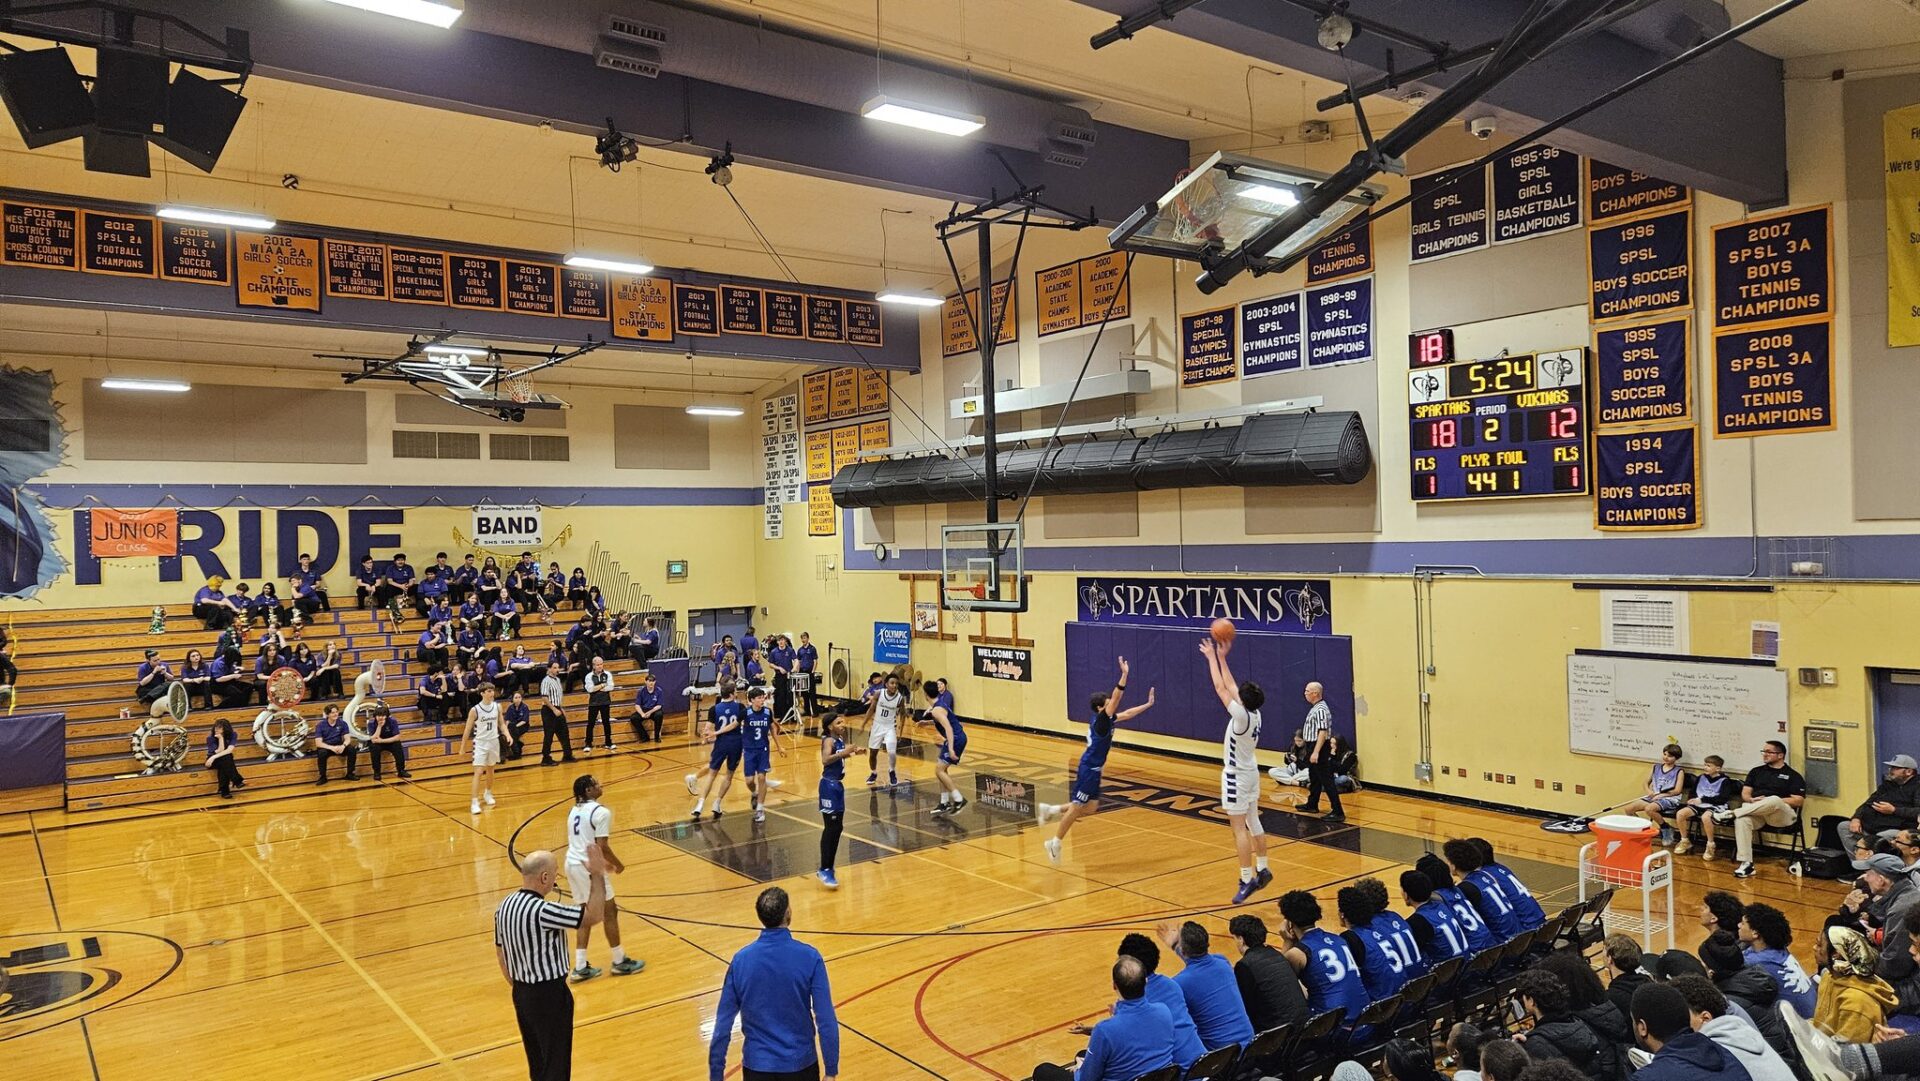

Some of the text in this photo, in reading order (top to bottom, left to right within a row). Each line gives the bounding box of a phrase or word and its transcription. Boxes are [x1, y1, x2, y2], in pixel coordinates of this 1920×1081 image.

[1520, 166, 1550, 182] SPSL
[1890, 161, 1912, 174] We're
[1592, 174, 1625, 192] BOYS
[1518, 182, 1553, 199] GIRLS
[1433, 194, 1462, 209] SPSL
[1600, 186, 1677, 212] CHAMPIONS
[24, 208, 55, 218] 2012
[1497, 195, 1576, 221] BASKETBALL
[6, 216, 72, 230] WEST CENTRAL
[104, 221, 134, 231] 2012
[1412, 209, 1486, 235] GIRLS TENNIS
[1501, 212, 1571, 237] CHAMPIONS
[10, 224, 69, 238] DISTRICT III
[97, 232, 142, 244] SPSL 2A
[180, 228, 208, 238] 2012
[1621, 224, 1655, 242] 1996
[1748, 222, 1791, 242] 2007
[29, 236, 51, 244] BOYS
[173, 237, 215, 248] SPSL 2A
[264, 236, 292, 246] 2012
[1418, 232, 1479, 255] CHAMPIONS
[6, 242, 72, 256] CROSS COUNTRY
[98, 245, 141, 256] FOOTBALL
[183, 248, 207, 257] GIRLS
[250, 244, 305, 257] WIAA 2A
[330, 244, 382, 255] 2012-2013
[1322, 243, 1356, 259] TENNIS
[1728, 238, 1811, 264] SPSL 3A
[15, 252, 64, 264] CHAMPIONS
[96, 257, 143, 268] CHAMPIONS
[180, 257, 211, 267] SOCCER
[244, 252, 312, 267] GIRLS SOCCER
[352, 254, 381, 263] CENTRAL
[392, 254, 442, 265] 2012-2013
[1096, 257, 1111, 268] 2000
[1619, 248, 1657, 265] SPSL
[333, 260, 364, 269] DISTRICT
[392, 265, 442, 276] SPECIAL OLYMPICS
[464, 260, 486, 269] 2013
[1313, 254, 1366, 275] CHAMPIONS
[1746, 260, 1792, 279] BOYS
[173, 266, 217, 278] CHAMPIONS
[459, 269, 477, 277] SPSL
[1090, 268, 1118, 282] ACADEMIC
[1593, 265, 1687, 292] BOYS SOCCER
[261, 275, 298, 286] STATE
[350, 278, 383, 287] BASKETBALL
[397, 276, 439, 286] BASKETBALL
[467, 278, 485, 286] GIRLS
[1045, 281, 1072, 293] ACADEMIC
[1095, 282, 1113, 293] STATE
[248, 283, 312, 296] CHAMPIONS
[338, 285, 377, 294] CHAMPIONS
[415, 289, 443, 297] CHAMPIONS
[466, 287, 488, 295] TENNIS
[1739, 277, 1801, 299] TENNIS
[459, 295, 494, 305] CHAMPIONS
[1050, 294, 1067, 305] STATE
[1320, 290, 1357, 306] 1998-99
[1601, 290, 1680, 314] CHAMPIONS
[1048, 306, 1070, 317] CHAMPS
[1246, 302, 1295, 321] 2003-2004
[1721, 294, 1820, 320] CHAMPIONS
[1085, 312, 1099, 321] BOYS
[1194, 315, 1223, 329] 1997-98
[1325, 310, 1352, 322] SPSL
[1043, 317, 1075, 331] GYMNASTICS
[1259, 321, 1283, 333] SPSL
[1193, 329, 1224, 341] SPECIAL
[1311, 323, 1367, 341] GYMNASTICS
[1624, 328, 1656, 344] 1995
[1190, 340, 1227, 354] OLYMPICS
[1243, 333, 1300, 351] GYMNASTICS
[1313, 341, 1365, 357] CHAMPIONS
[1419, 334, 1442, 362] 18
[1749, 334, 1793, 352] 2008
[1185, 352, 1232, 367] BASKETBALL
[1246, 350, 1297, 366] CHAMPIONS
[1622, 347, 1659, 362] SPSL
[1730, 351, 1813, 372] SPSL 3A
[1183, 364, 1236, 380] STATE CHAMPS
[1469, 360, 1532, 393] 5:24
[1623, 366, 1659, 382] BOYS
[1749, 371, 1794, 389] BOYS
[1611, 385, 1666, 400] SOCCER
[1741, 390, 1803, 407] TENNIS
[1416, 390, 1570, 418] SPARTANS PERIOD VIKINGS
[1602, 403, 1682, 421] CHAMPIONS
[1724, 407, 1823, 428] CHAMPIONS
[1432, 408, 1577, 448] 18 2 12
[1625, 438, 1662, 452] 1994
[1415, 446, 1578, 471] FLS PLYR FOUL FLS
[1626, 462, 1663, 475] SPSL
[1429, 466, 1578, 494] 1 44 1 1
[1600, 484, 1692, 499] BOYS SOCCER
[1606, 508, 1686, 522] CHAMPIONS
[95, 522, 167, 540] JUNIOR
[478, 517, 537, 534] BAND
[117, 544, 148, 552] CLASS
[1112, 583, 1283, 625] SPARTANS
[885, 630, 907, 638] OLYMPIC
[978, 648, 1025, 660] WELCOME TO
[881, 709, 888, 717] 10
[754, 728, 761, 740] 3
[574, 816, 580, 835] 2
[1318, 945, 1360, 983] 34
